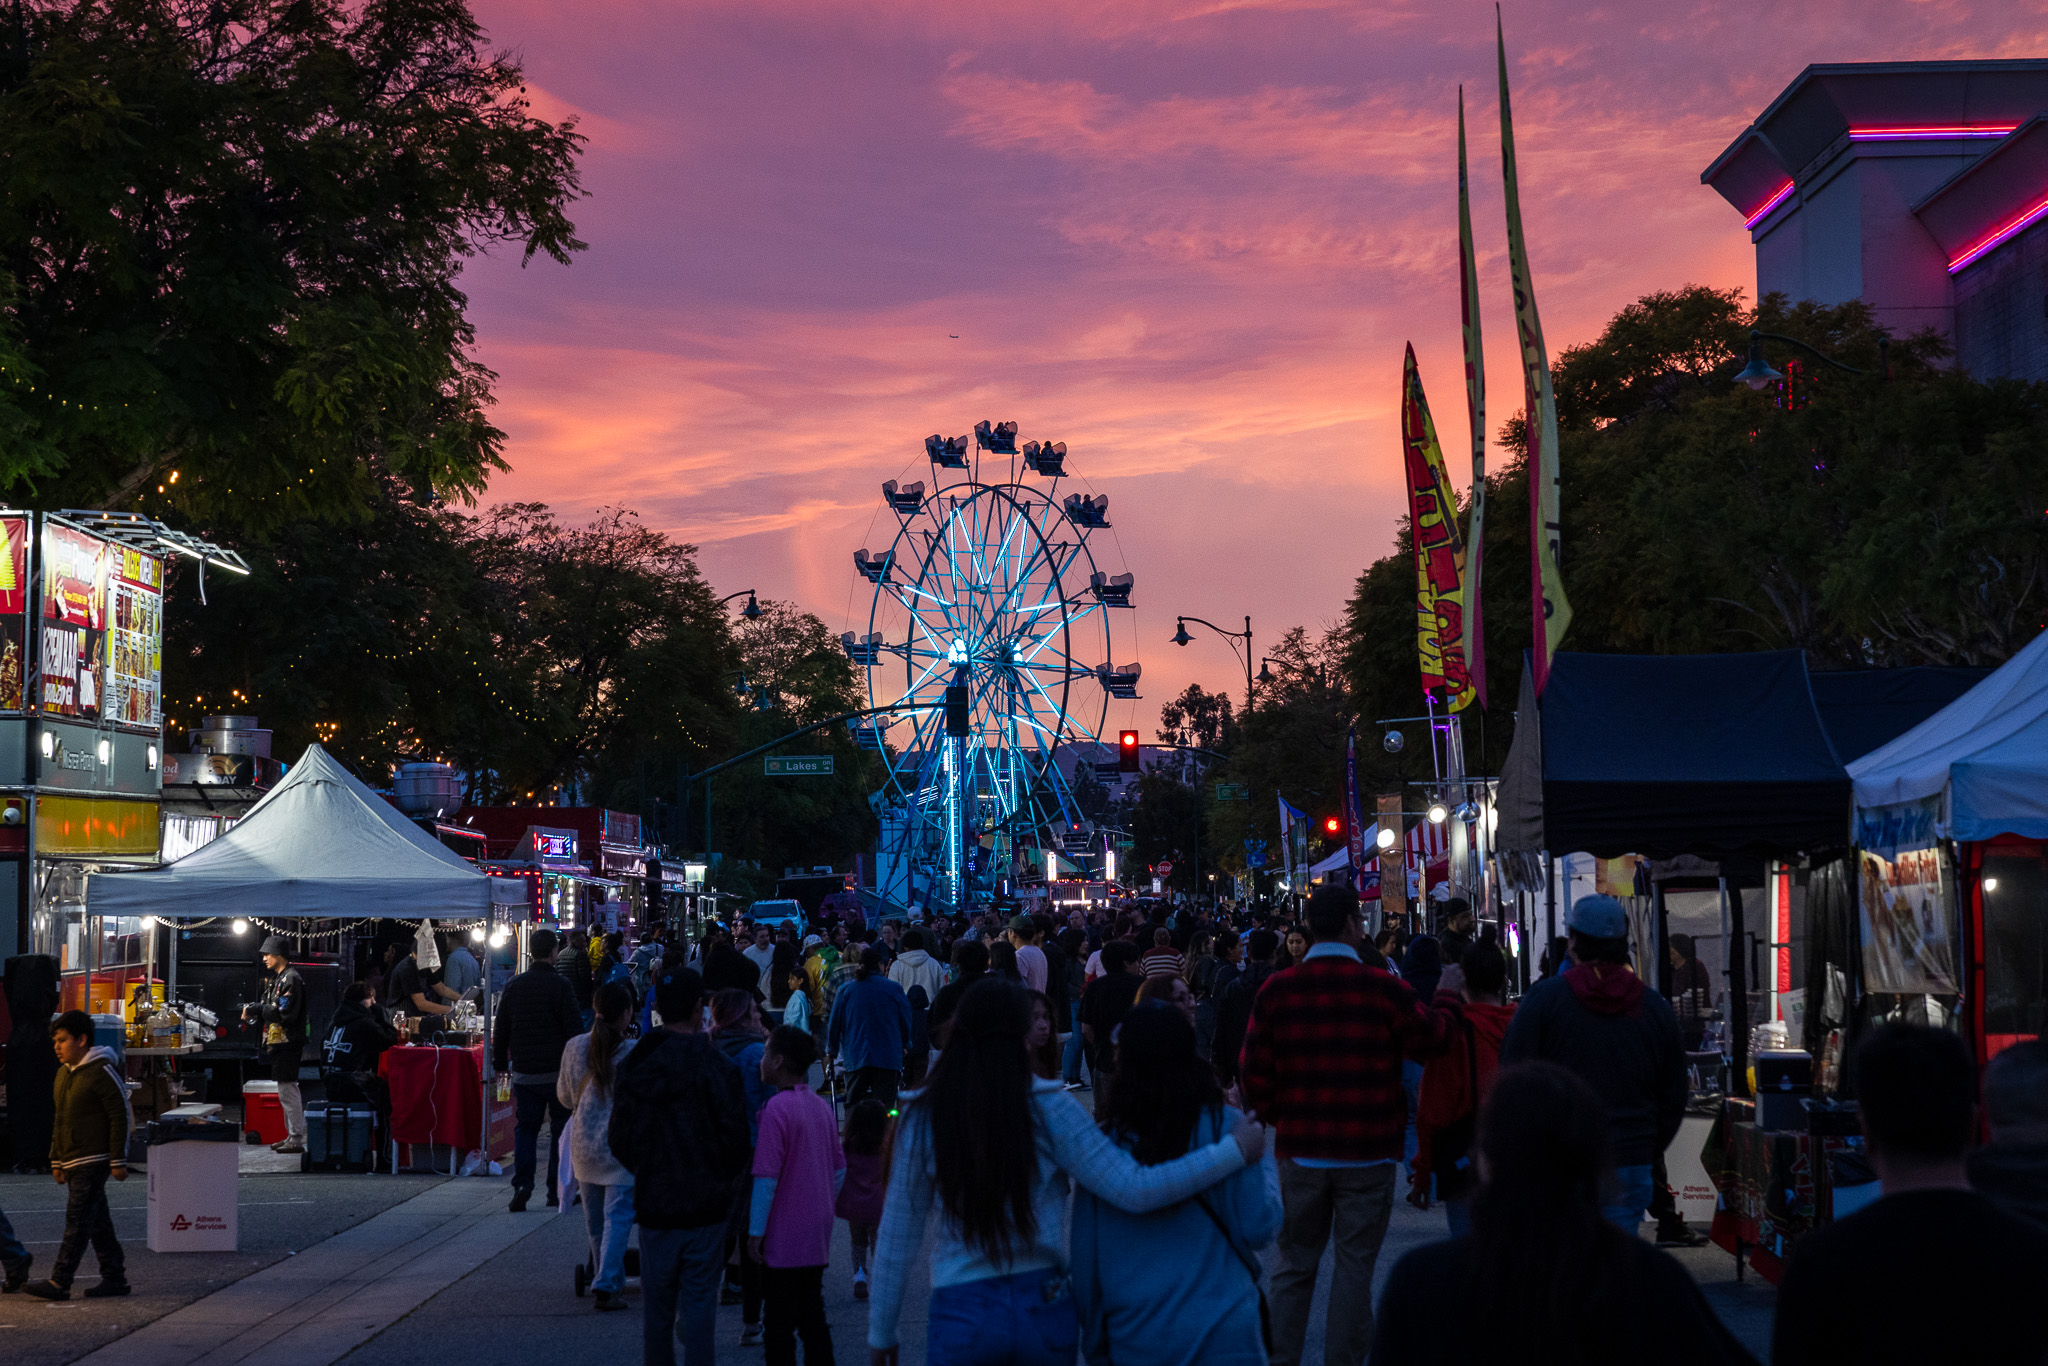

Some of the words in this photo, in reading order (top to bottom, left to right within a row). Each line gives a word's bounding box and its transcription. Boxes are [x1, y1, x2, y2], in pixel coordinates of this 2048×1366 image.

[786, 761, 817, 771] Lakes
[1682, 1192, 1715, 1200] Services
[196, 1215, 222, 1223] Athens
